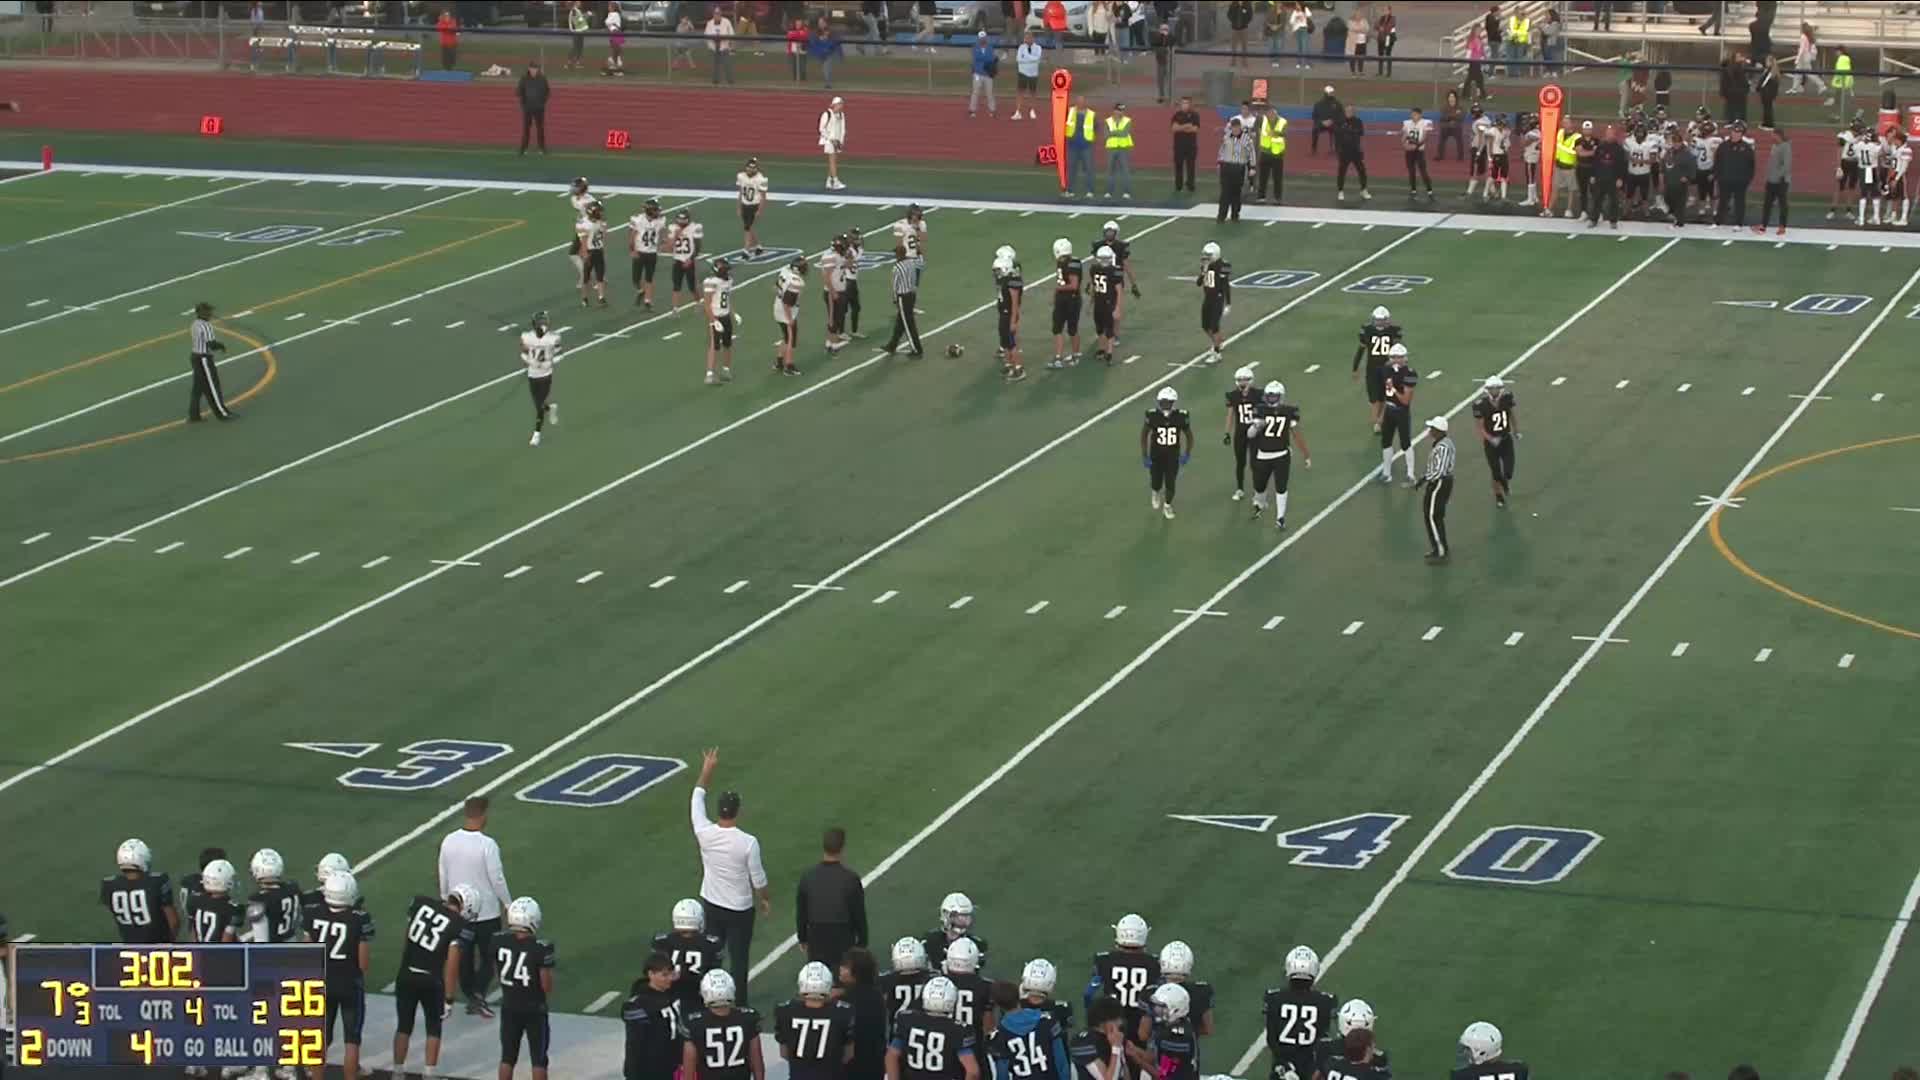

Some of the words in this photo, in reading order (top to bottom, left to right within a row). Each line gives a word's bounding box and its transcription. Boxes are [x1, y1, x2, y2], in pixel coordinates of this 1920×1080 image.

[1093, 274, 1108, 294] 55
[1370, 335, 1392, 356] 26
[1237, 403, 1254, 424] 15
[1264, 416, 1287, 438] 27
[1156, 427, 1177, 446] 36
[111, 889, 151, 926] 99
[312, 919, 347, 960] 72
[408, 904, 449, 952] 63
[498, 947, 531, 987] 24
[791, 1017, 831, 1060] 77
[1278, 1003, 1318, 1046] 23
[705, 1025, 745, 1068] 52
[907, 1027, 946, 1072] 58
[1007, 1031, 1049, 1077] 34
